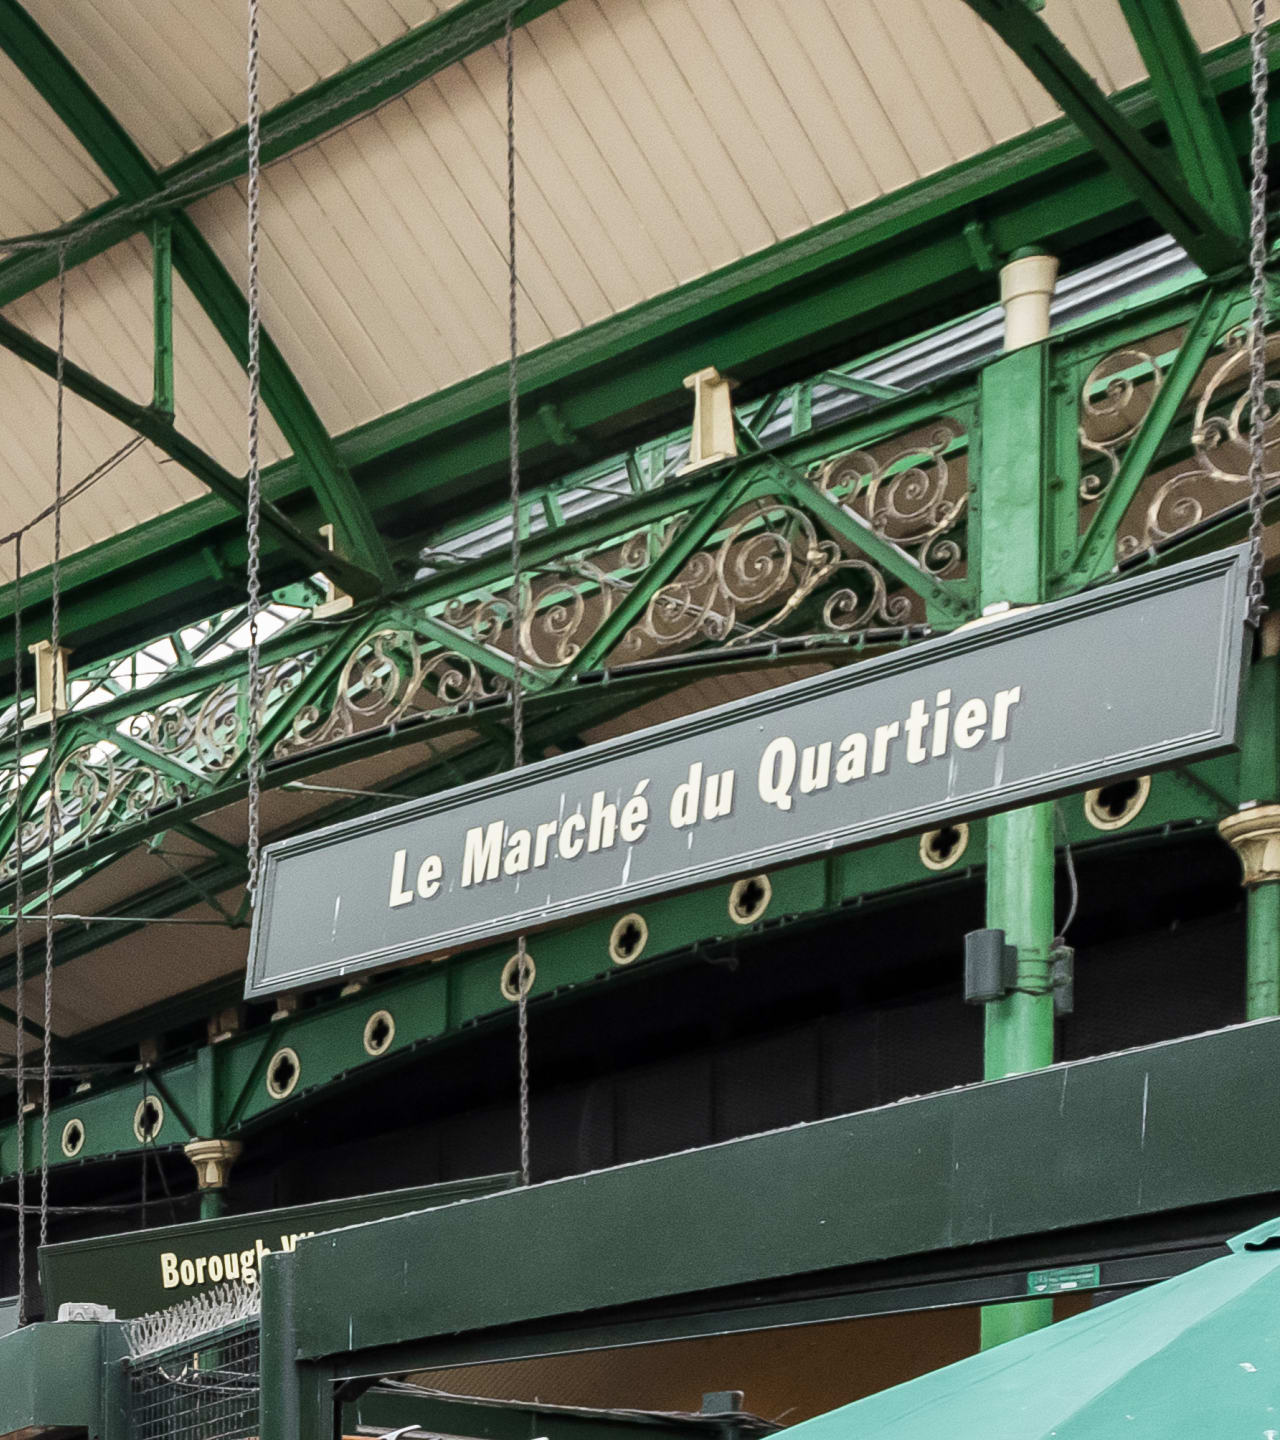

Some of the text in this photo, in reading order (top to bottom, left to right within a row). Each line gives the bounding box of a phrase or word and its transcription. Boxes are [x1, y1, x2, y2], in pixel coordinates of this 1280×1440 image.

[388, 682, 1023, 910] Le Marché du Quartier
[160, 1239, 271, 1288] Borough
